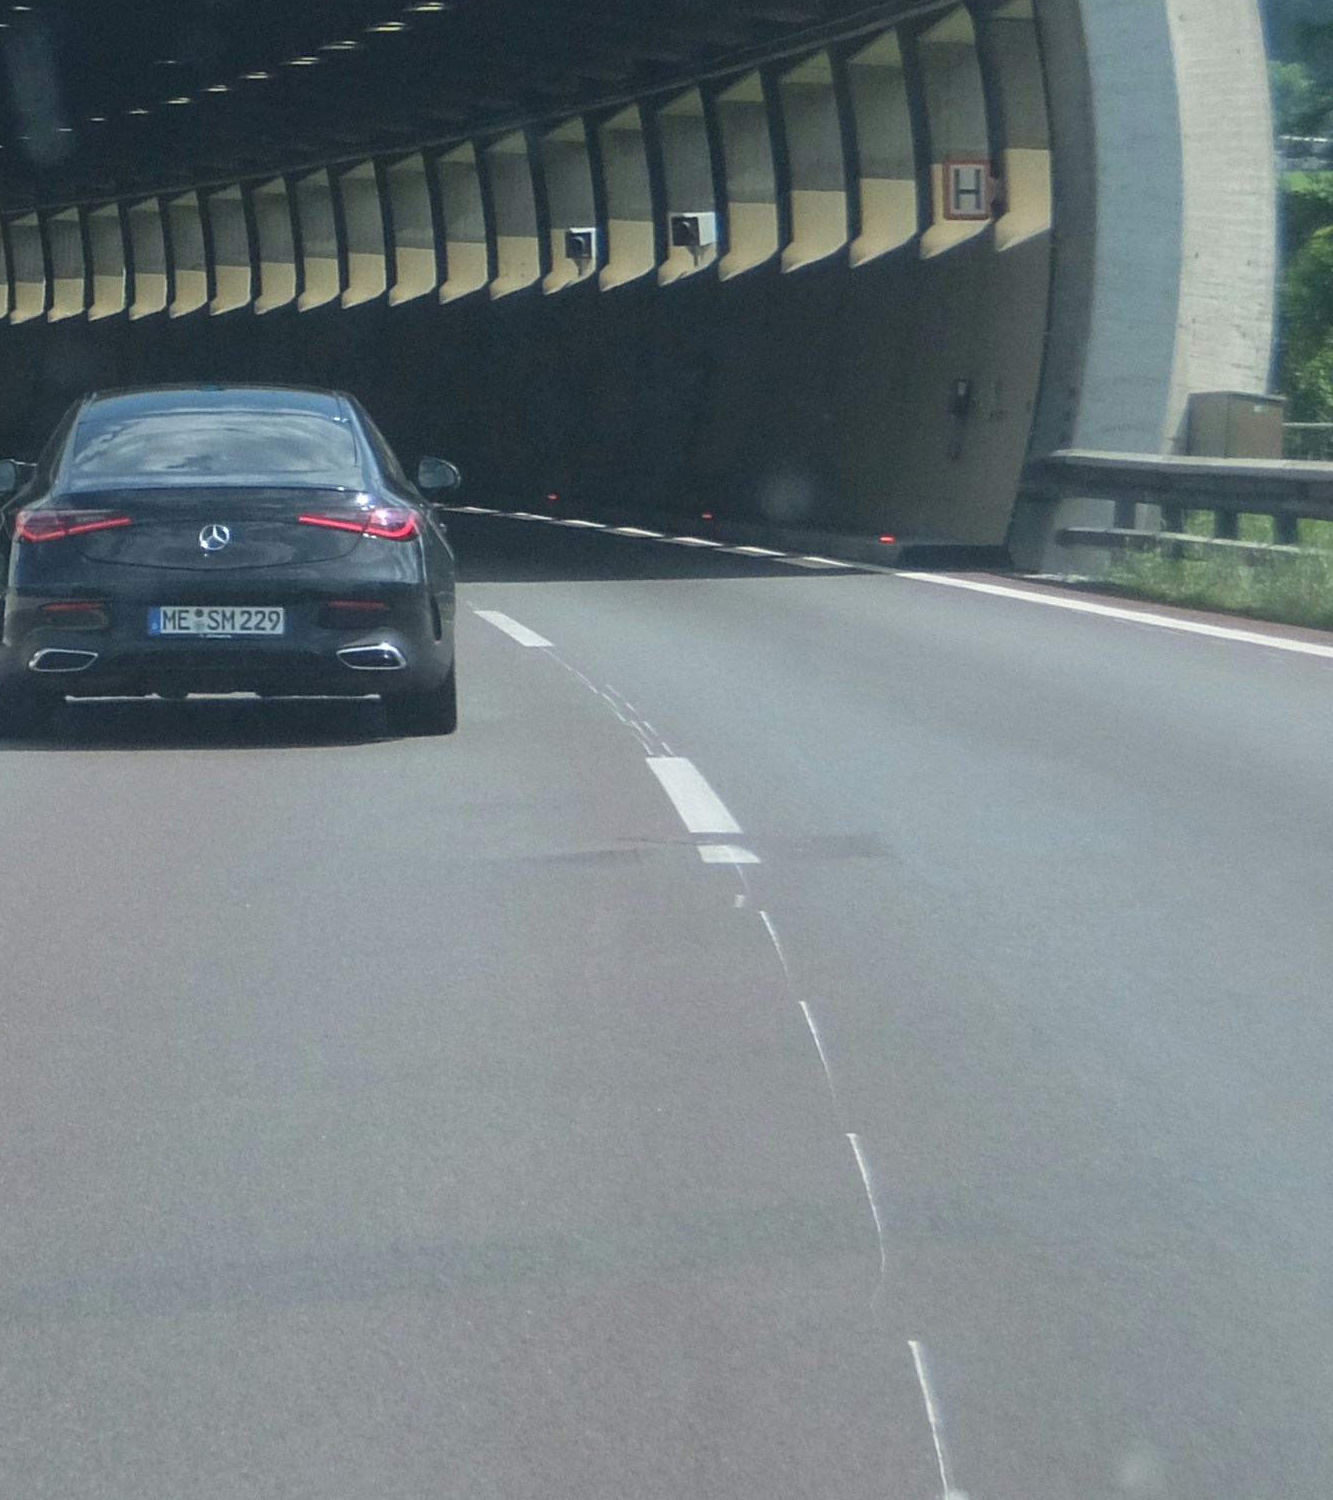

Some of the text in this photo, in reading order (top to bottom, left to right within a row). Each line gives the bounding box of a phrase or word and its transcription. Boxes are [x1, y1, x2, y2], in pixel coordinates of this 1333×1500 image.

[953, 168, 982, 210] H
[162, 609, 191, 631] ME
[206, 609, 235, 631] SM
[239, 609, 282, 631] 229
